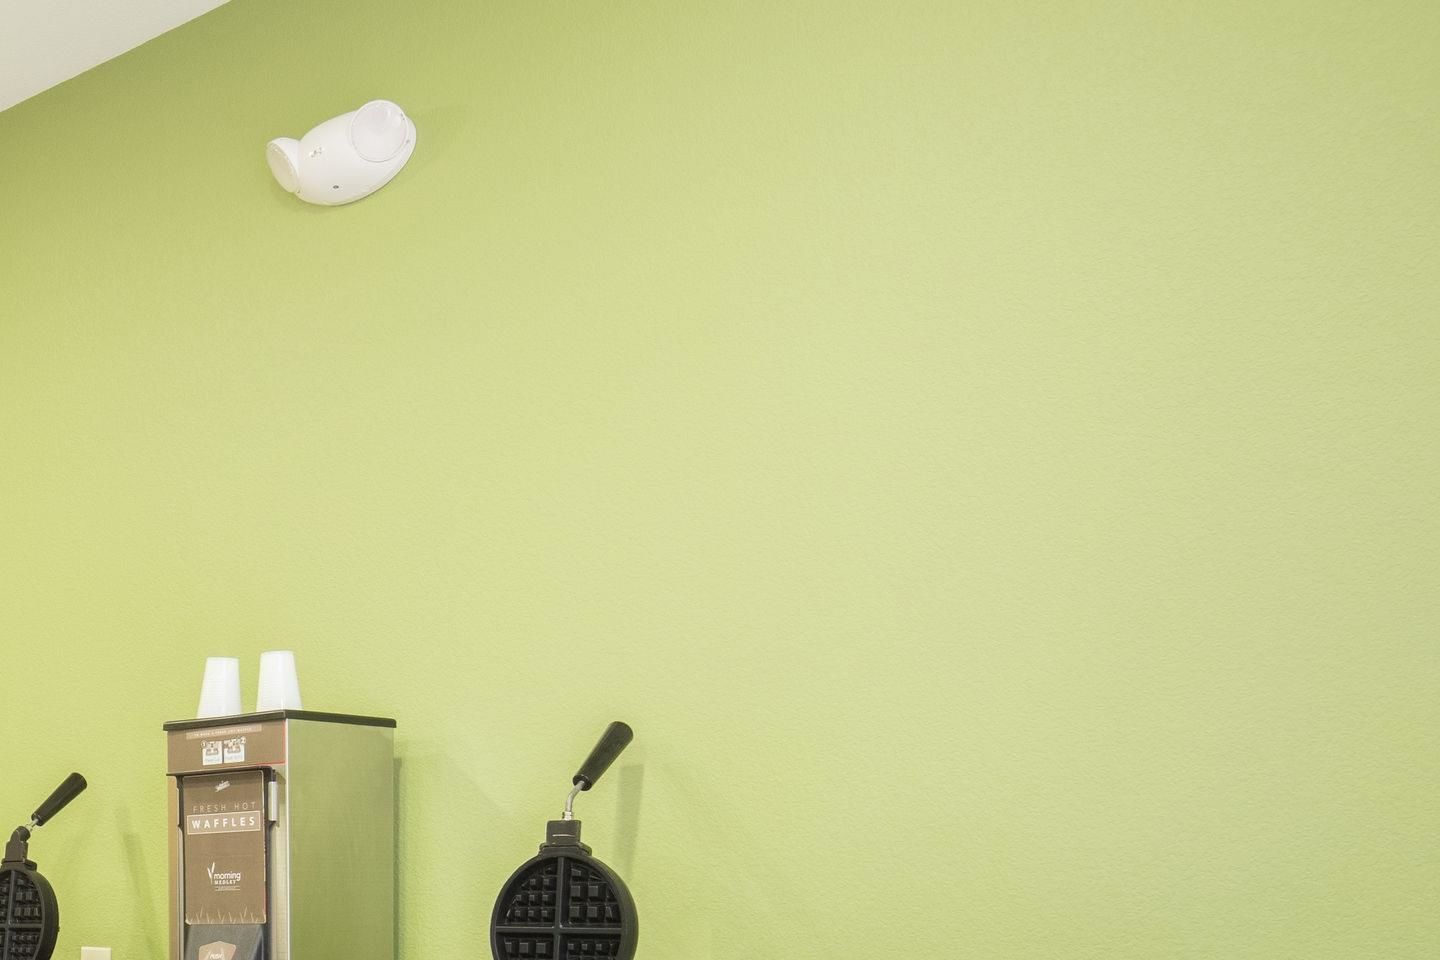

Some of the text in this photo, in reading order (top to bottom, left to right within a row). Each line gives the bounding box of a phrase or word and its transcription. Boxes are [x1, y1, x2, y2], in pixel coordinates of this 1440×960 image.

[193, 801, 256, 813] FRESH HOT
[191, 816, 255, 829] WAFFLES
[213, 871, 241, 881] morning
